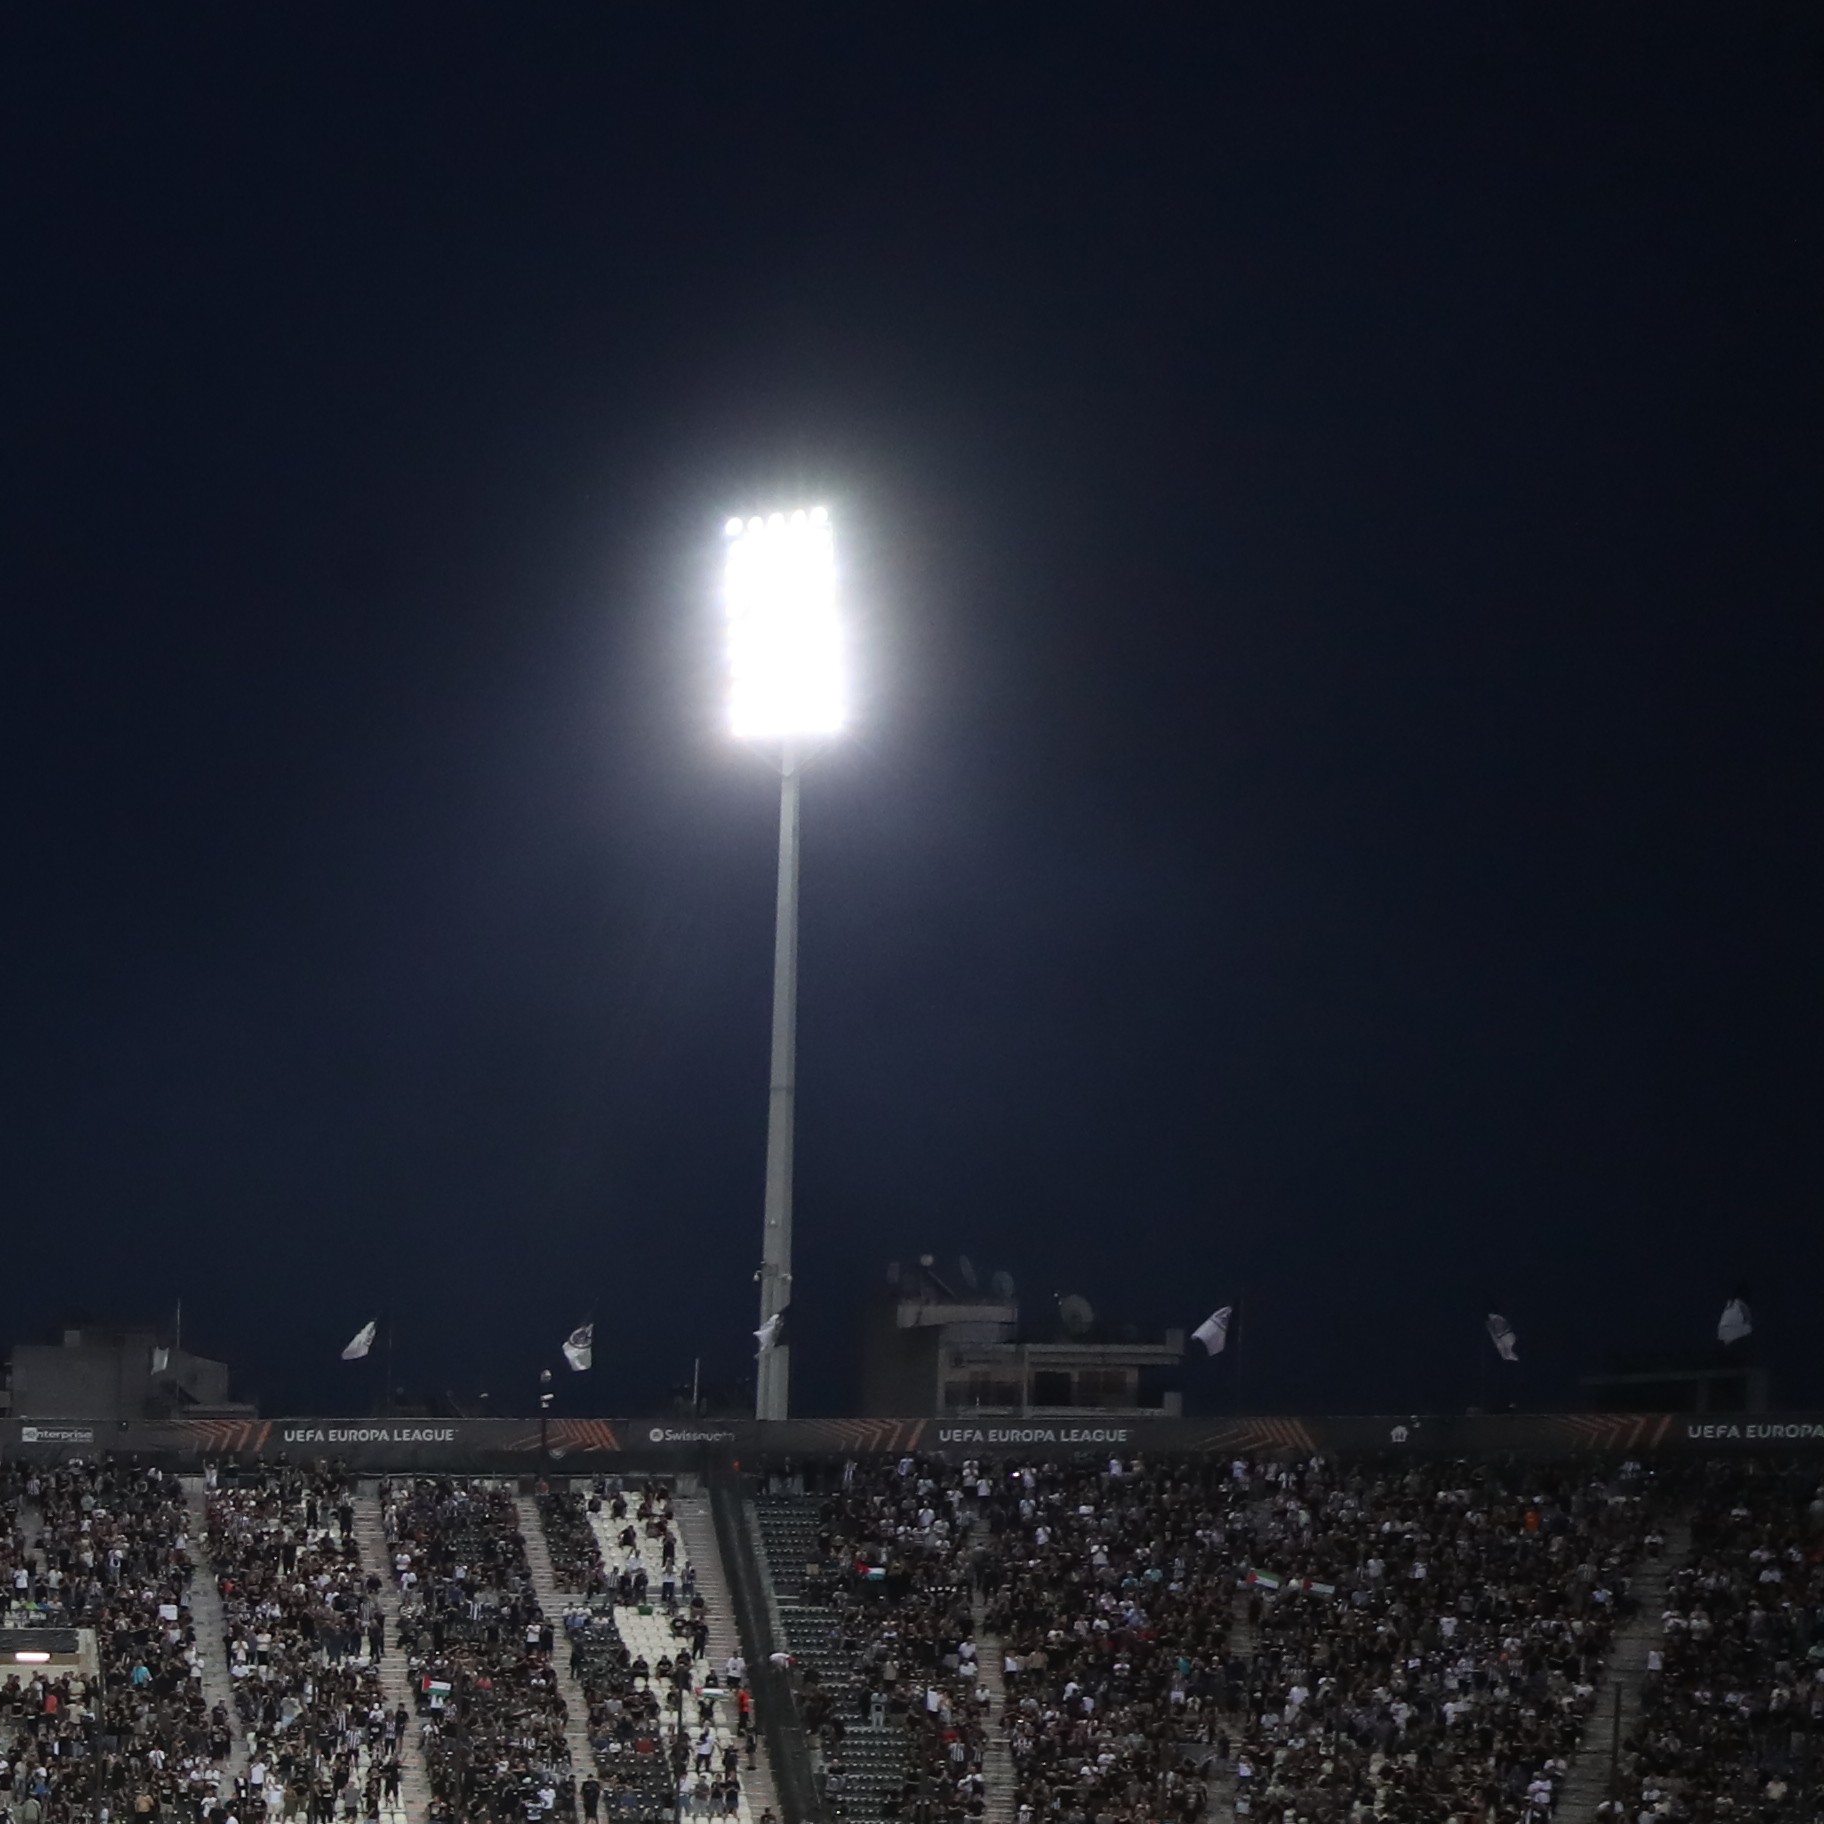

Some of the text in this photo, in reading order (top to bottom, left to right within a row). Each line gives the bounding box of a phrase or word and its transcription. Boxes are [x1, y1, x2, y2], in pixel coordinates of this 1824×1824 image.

[284, 1429, 454, 1442] UEFA EUROPA LEAGUE
[939, 1429, 1127, 1442] UEFA EUROPA LEAGUE
[1688, 1424, 1824, 1439] UEFA EUROPA
